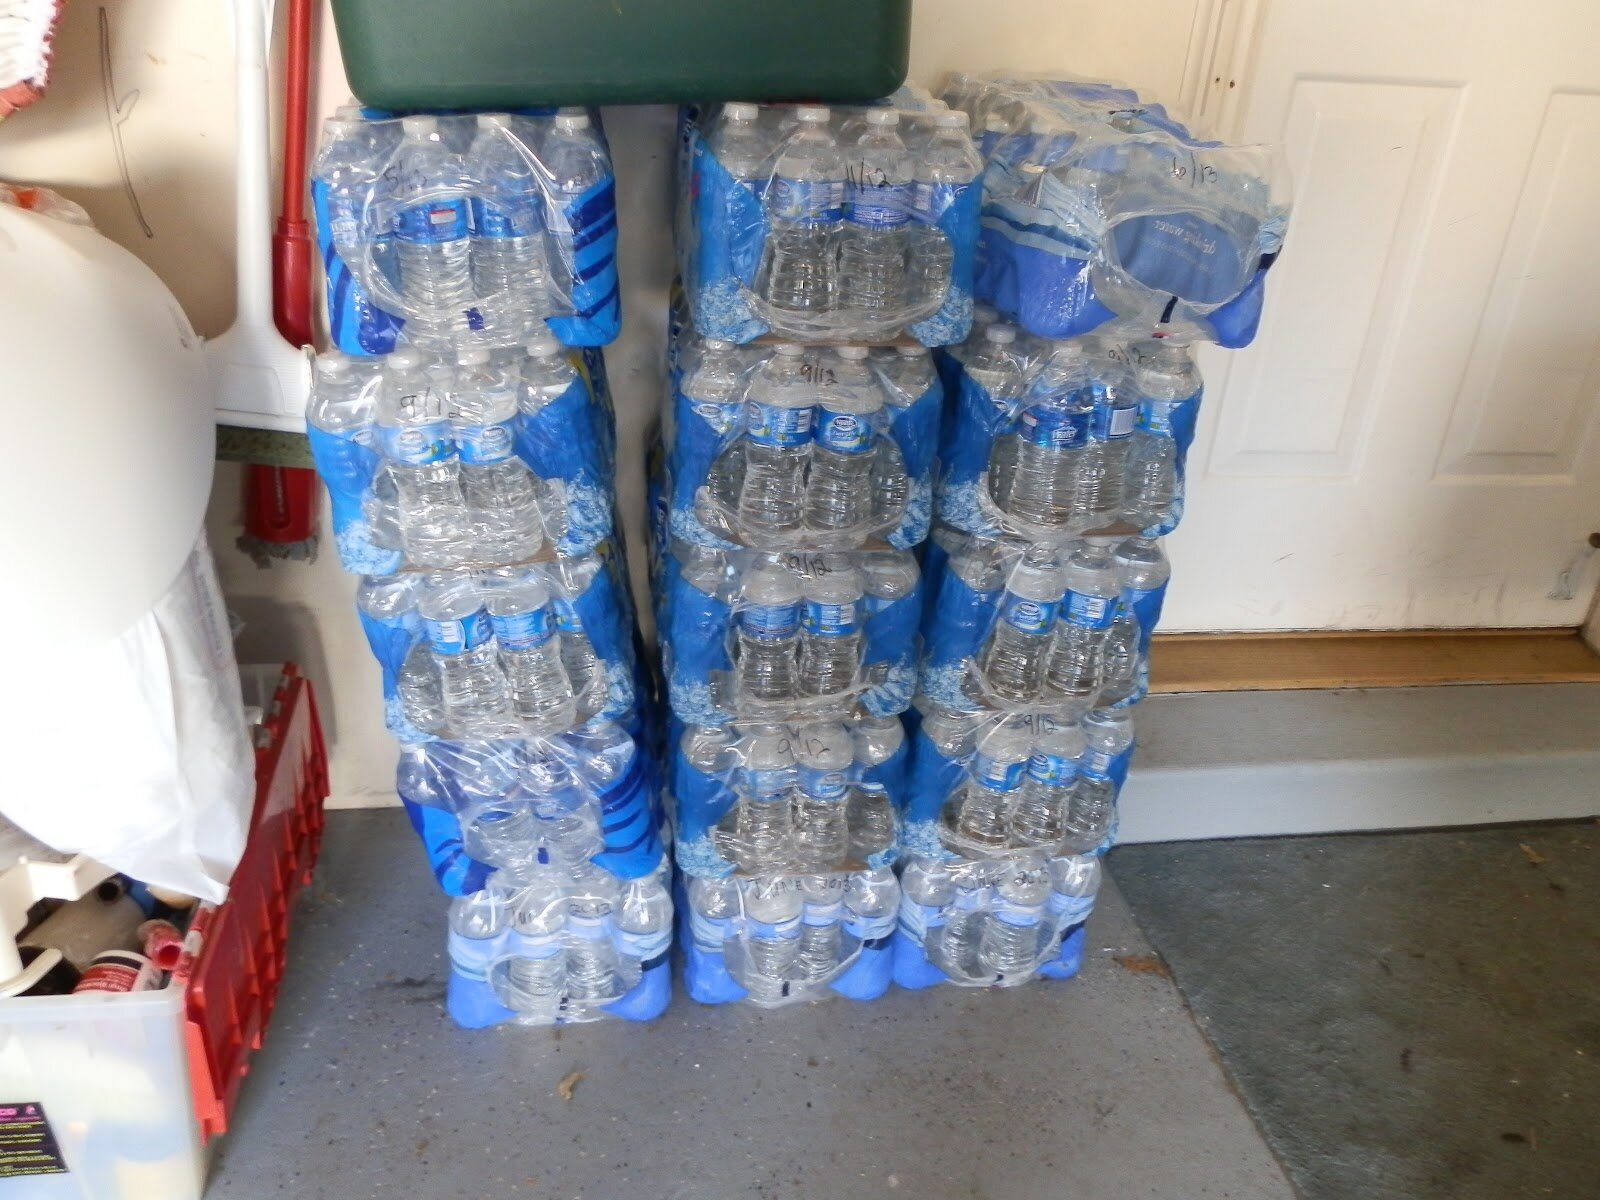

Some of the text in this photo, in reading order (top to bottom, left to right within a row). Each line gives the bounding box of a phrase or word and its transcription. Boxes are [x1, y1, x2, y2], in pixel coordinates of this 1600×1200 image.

[845, 156, 893, 196] 11/12
[1168, 151, 1218, 189] 6/13
[800, 359, 840, 387] 9/12
